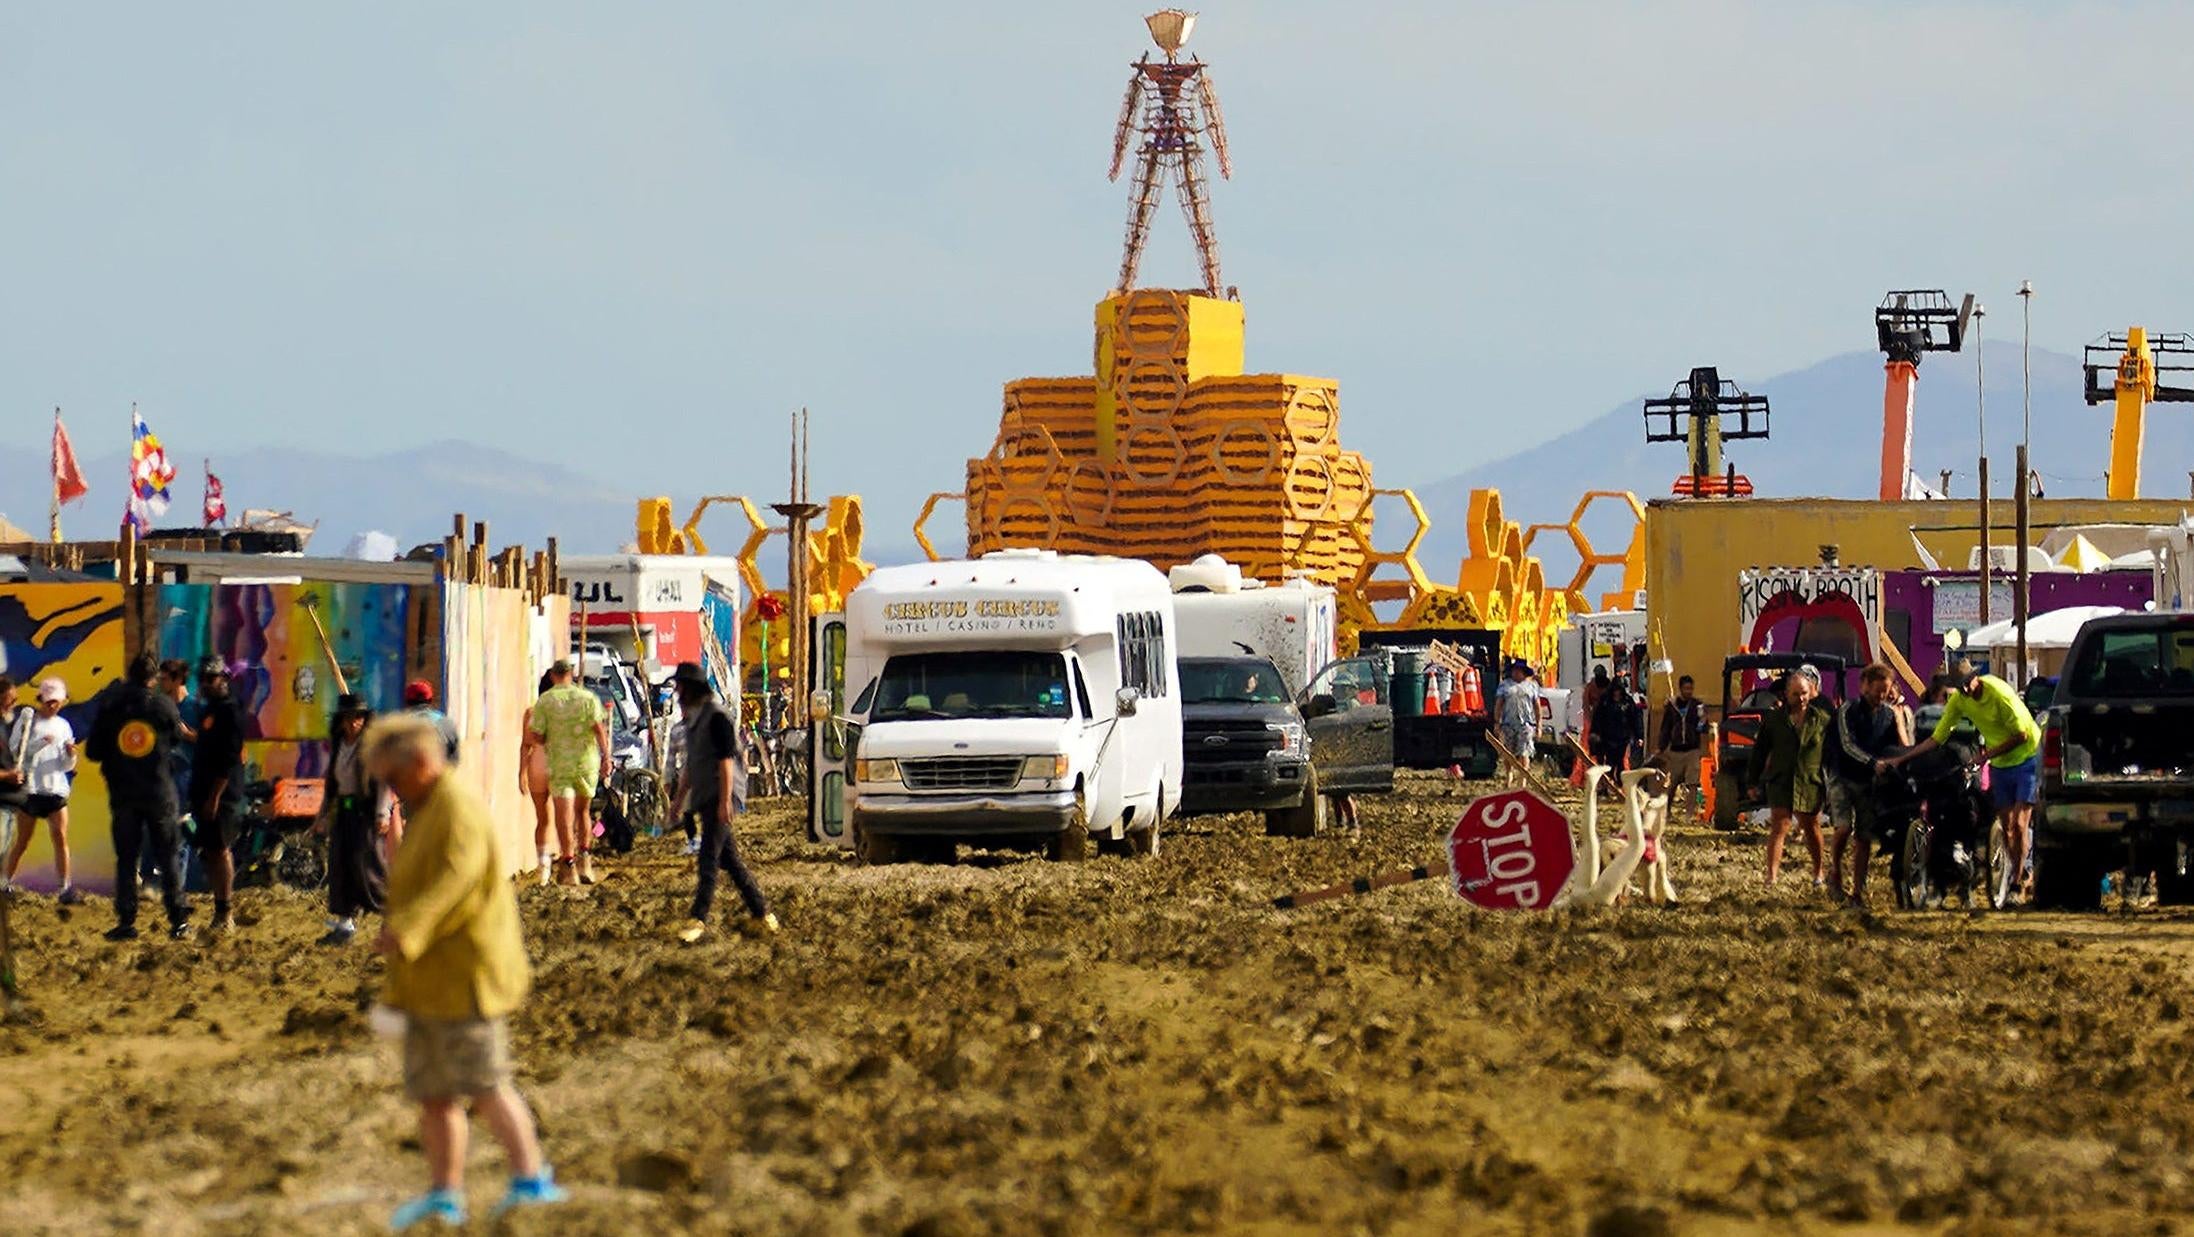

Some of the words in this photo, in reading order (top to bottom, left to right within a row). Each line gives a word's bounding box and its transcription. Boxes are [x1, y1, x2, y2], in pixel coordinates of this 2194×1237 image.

[883, 600, 968, 620] CIRCUS
[975, 599, 1061, 618] CIRCUS
[1816, 576, 1878, 622] BOOTH
[884, 622, 929, 634] HOTEL
[947, 619, 1000, 632] CASINO
[1019, 619, 1057, 631] RENO
[1481, 800, 1541, 908] STOP
